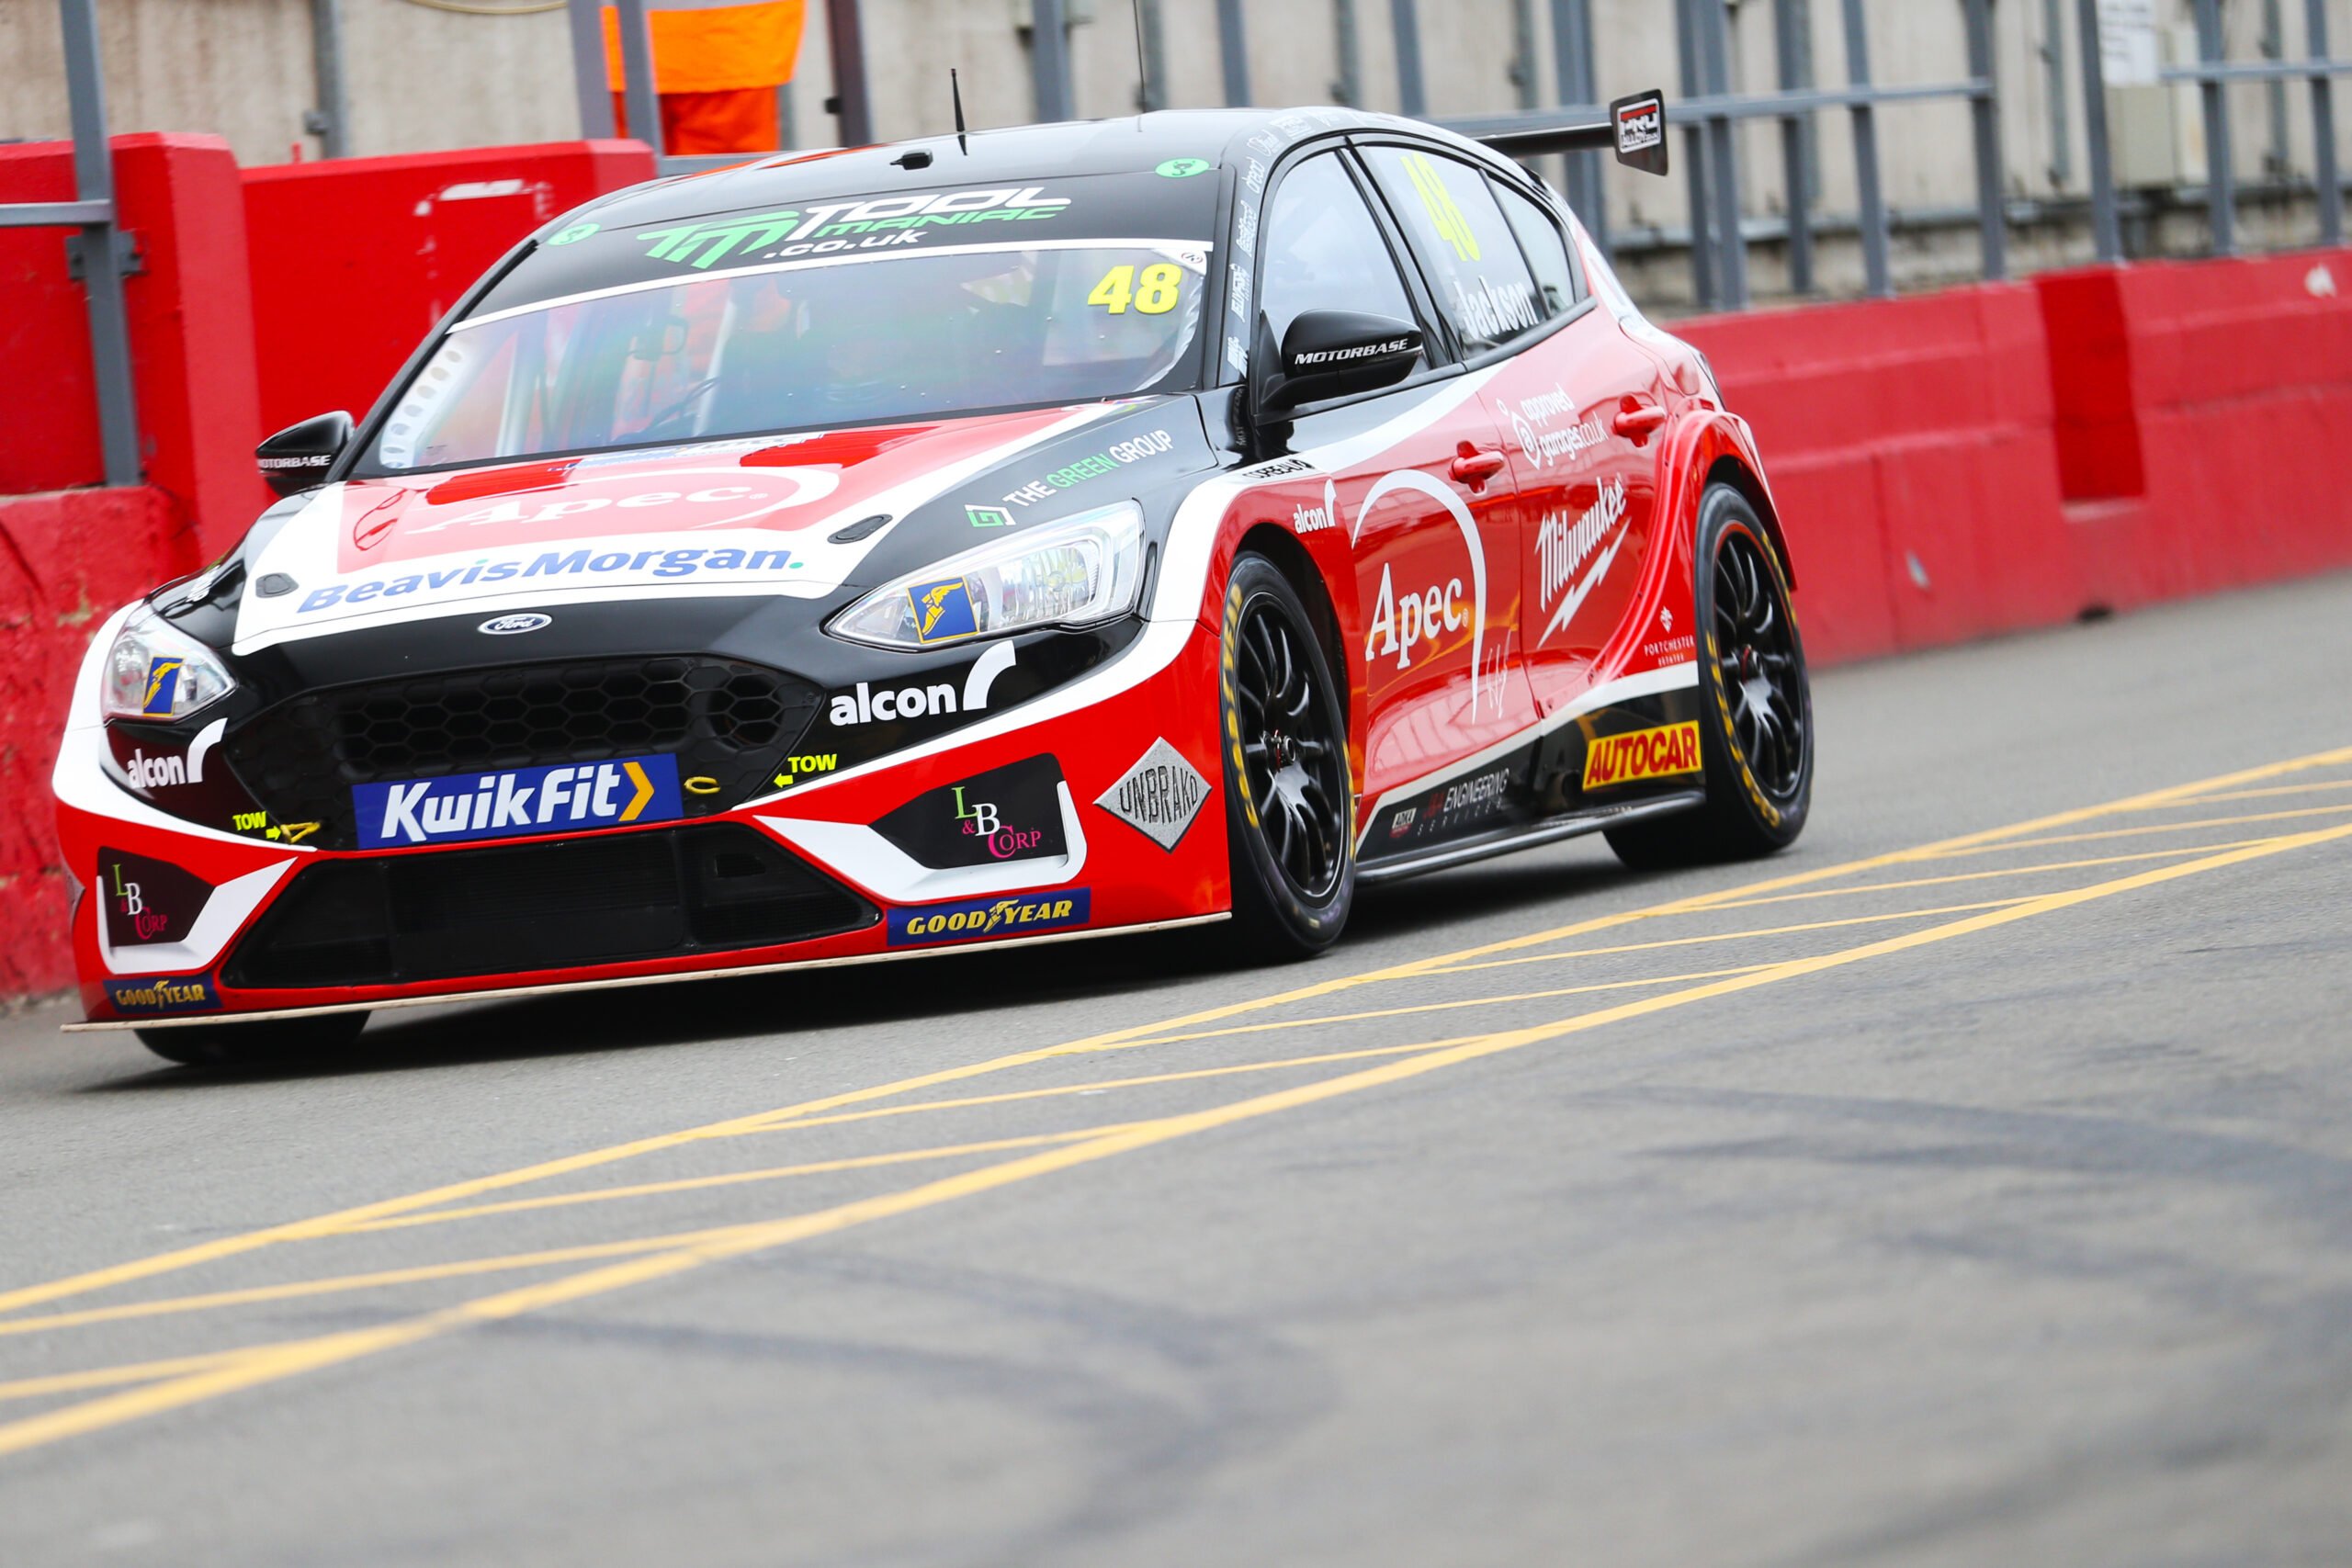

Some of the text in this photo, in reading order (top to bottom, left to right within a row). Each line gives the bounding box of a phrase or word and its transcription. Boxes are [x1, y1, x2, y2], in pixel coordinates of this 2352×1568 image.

[785, 187, 1071, 242] TOOL
[763, 229, 927, 259] .co.uk
[1088, 263, 1182, 315] 48
[1454, 275, 1539, 339] Jackson
[1295, 338, 1408, 365] MOTORBASE
[1520, 382, 1575, 427] approved
[1002, 430, 1174, 507] THE GREEN GROUP
[404, 487, 752, 535] Apec
[1293, 503, 1329, 534] alcon
[1534, 472, 1626, 613] Milwaukee
[494, 617, 536, 630] Ford
[1365, 562, 1463, 670] Apec
[1644, 634, 1695, 657] PORTCHESTER
[830, 682, 957, 726] alcon
[128, 748, 186, 789] alcon
[787, 753, 838, 773] TOW
[1587, 726, 1699, 786] AUTOCAR
[1119, 765, 1199, 825] UNBRAKO
[1443, 768, 1510, 812] ENGINEERING
[232, 810, 267, 831] TOW
[906, 898, 1074, 936] GOODYEAR
[115, 981, 207, 1008] GOODYEAR
